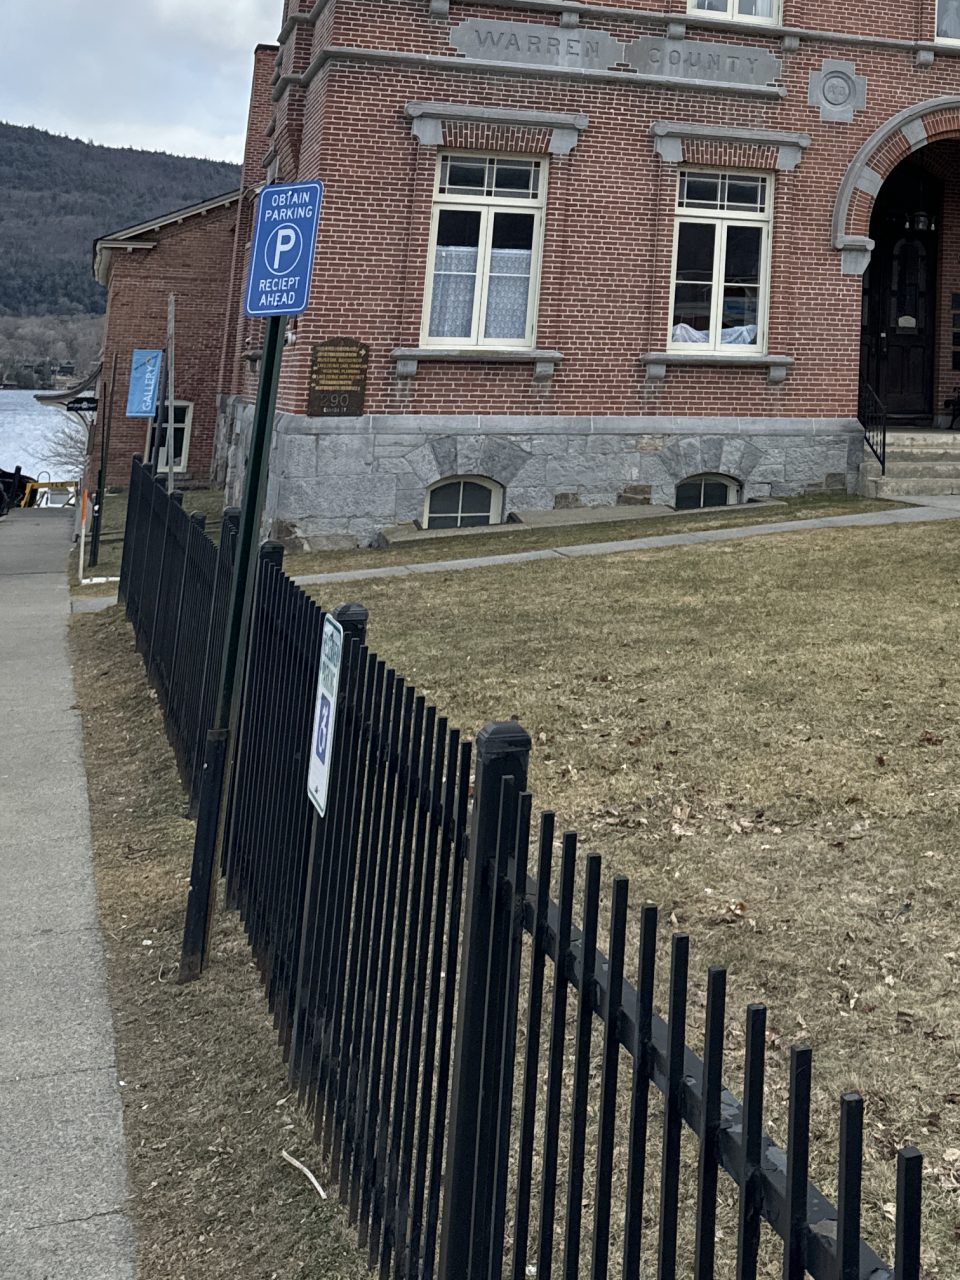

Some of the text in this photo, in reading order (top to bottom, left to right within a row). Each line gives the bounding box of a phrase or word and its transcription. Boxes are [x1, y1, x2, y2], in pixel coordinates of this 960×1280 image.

[474, 29, 759, 74] WARREN COUNTY
[271, 192, 310, 207] OBTAIN
[264, 206, 313, 222] PARKING
[273, 228, 296, 269] P
[258, 276, 300, 292] RECIEPT
[258, 292, 295, 307] AHEAD
[142, 365, 156, 410] GALLERY
[320, 393, 349, 407] 290
